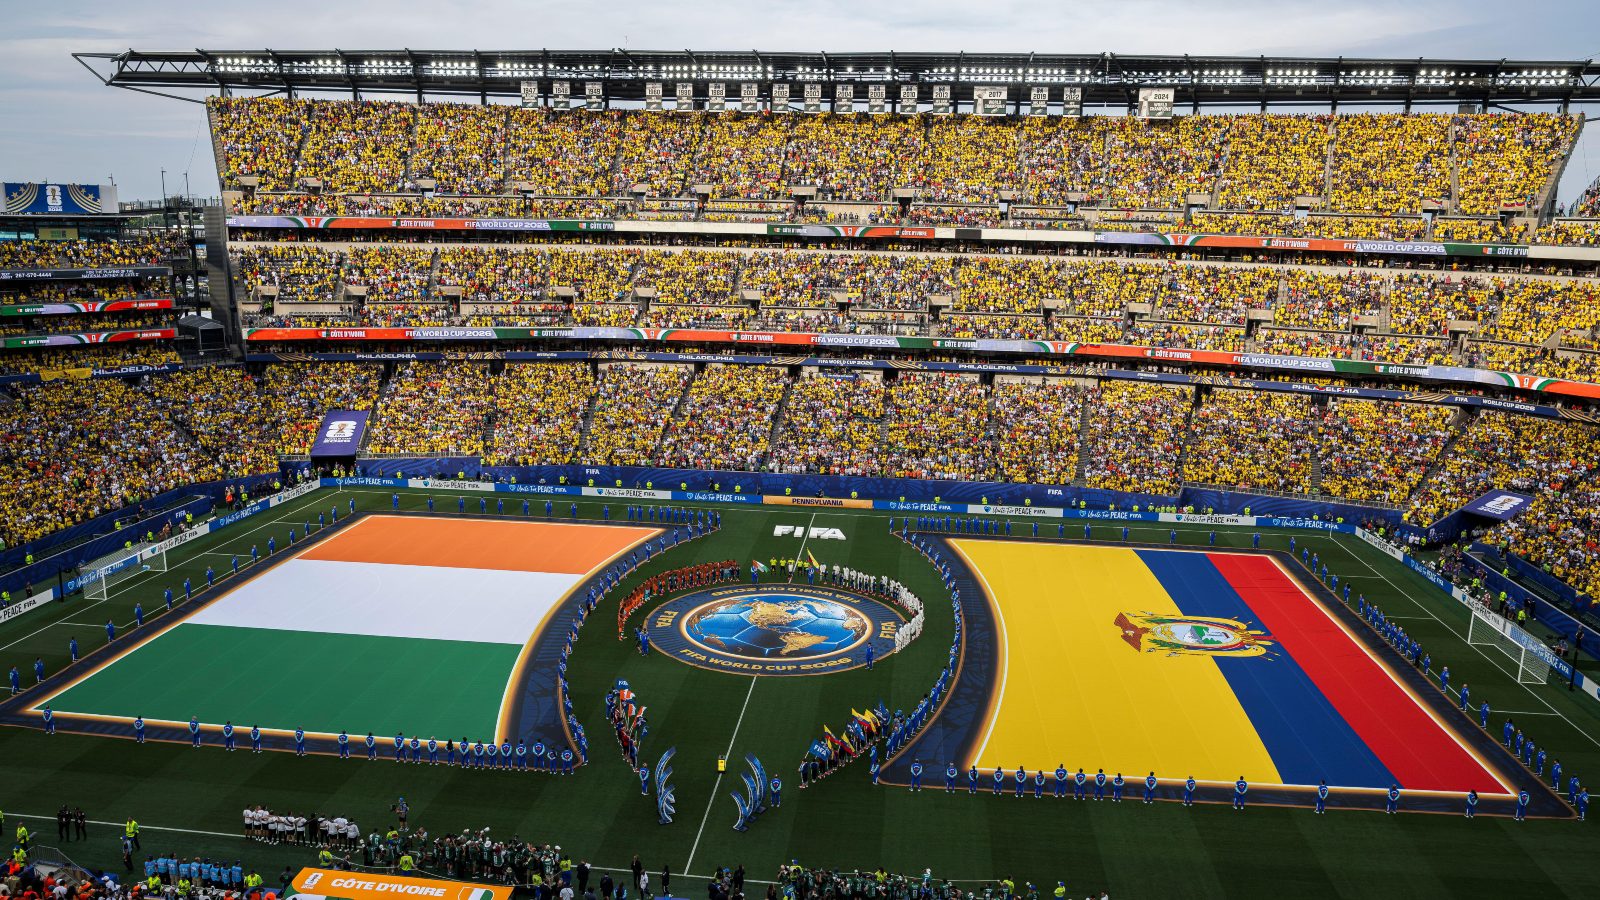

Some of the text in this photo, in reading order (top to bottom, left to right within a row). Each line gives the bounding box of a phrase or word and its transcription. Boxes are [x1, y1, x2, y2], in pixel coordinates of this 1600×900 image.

[176, 510, 186, 518] FIFA
[773, 525, 847, 541] FIFA
[3, 600, 37, 619] PEACE FIFA
[656, 610, 679, 628] FIFA
[880, 621, 896, 639] FIFA
[680, 648, 707, 661] FIFA
[709, 657, 763, 670] WORLD
[799, 657, 852, 669] 2026
[1545, 651, 1569, 674] PEACE FIFA
[813, 745, 826, 756] FIFA
[331, 879, 446, 897] CÔTE D'IVOIRE
